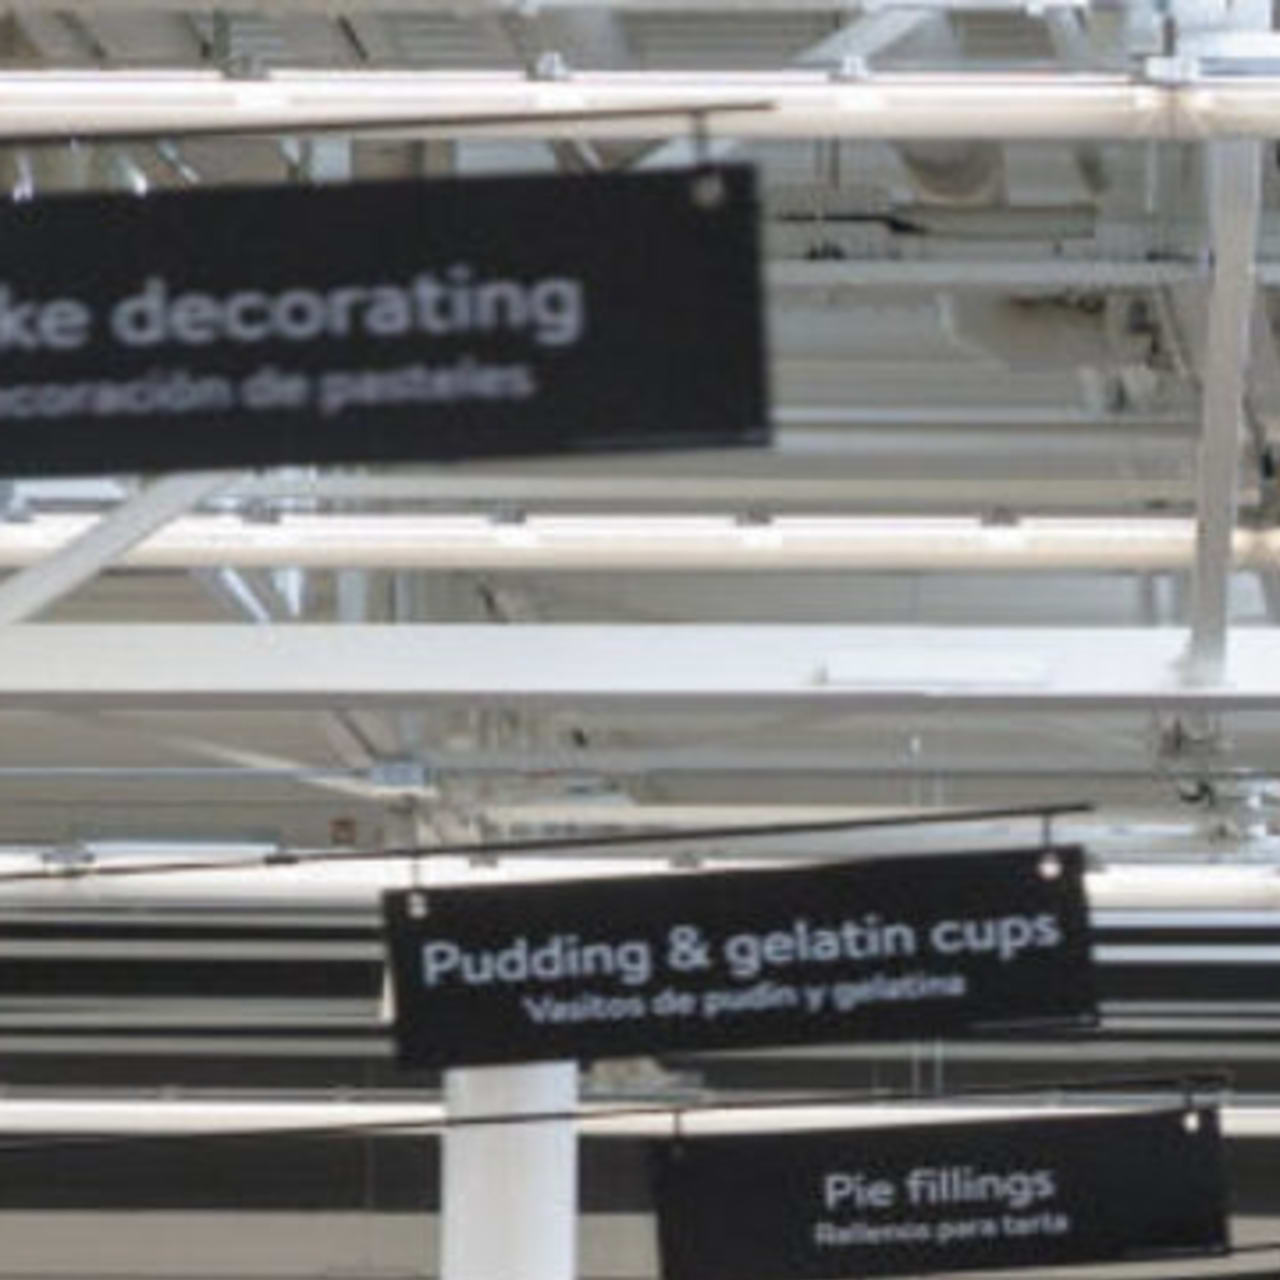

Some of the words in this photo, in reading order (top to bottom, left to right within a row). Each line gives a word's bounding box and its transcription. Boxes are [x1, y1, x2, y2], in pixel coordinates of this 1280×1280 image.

[111, 264, 584, 346] decorating
[240, 368, 311, 408] de
[422, 936, 652, 985] Pudding
[668, 926, 710, 970] &
[724, 915, 916, 976] gelatin
[930, 914, 1061, 960] cups
[523, 993, 644, 1023] Vasitos
[652, 988, 696, 1015] de
[805, 986, 828, 1011] y
[832, 974, 966, 1010] gelatina
[824, 1173, 894, 1209] Pie
[905, 1166, 1056, 1208] fillings
[936, 1219, 996, 1243] para
[1002, 1213, 1068, 1235] tarta
